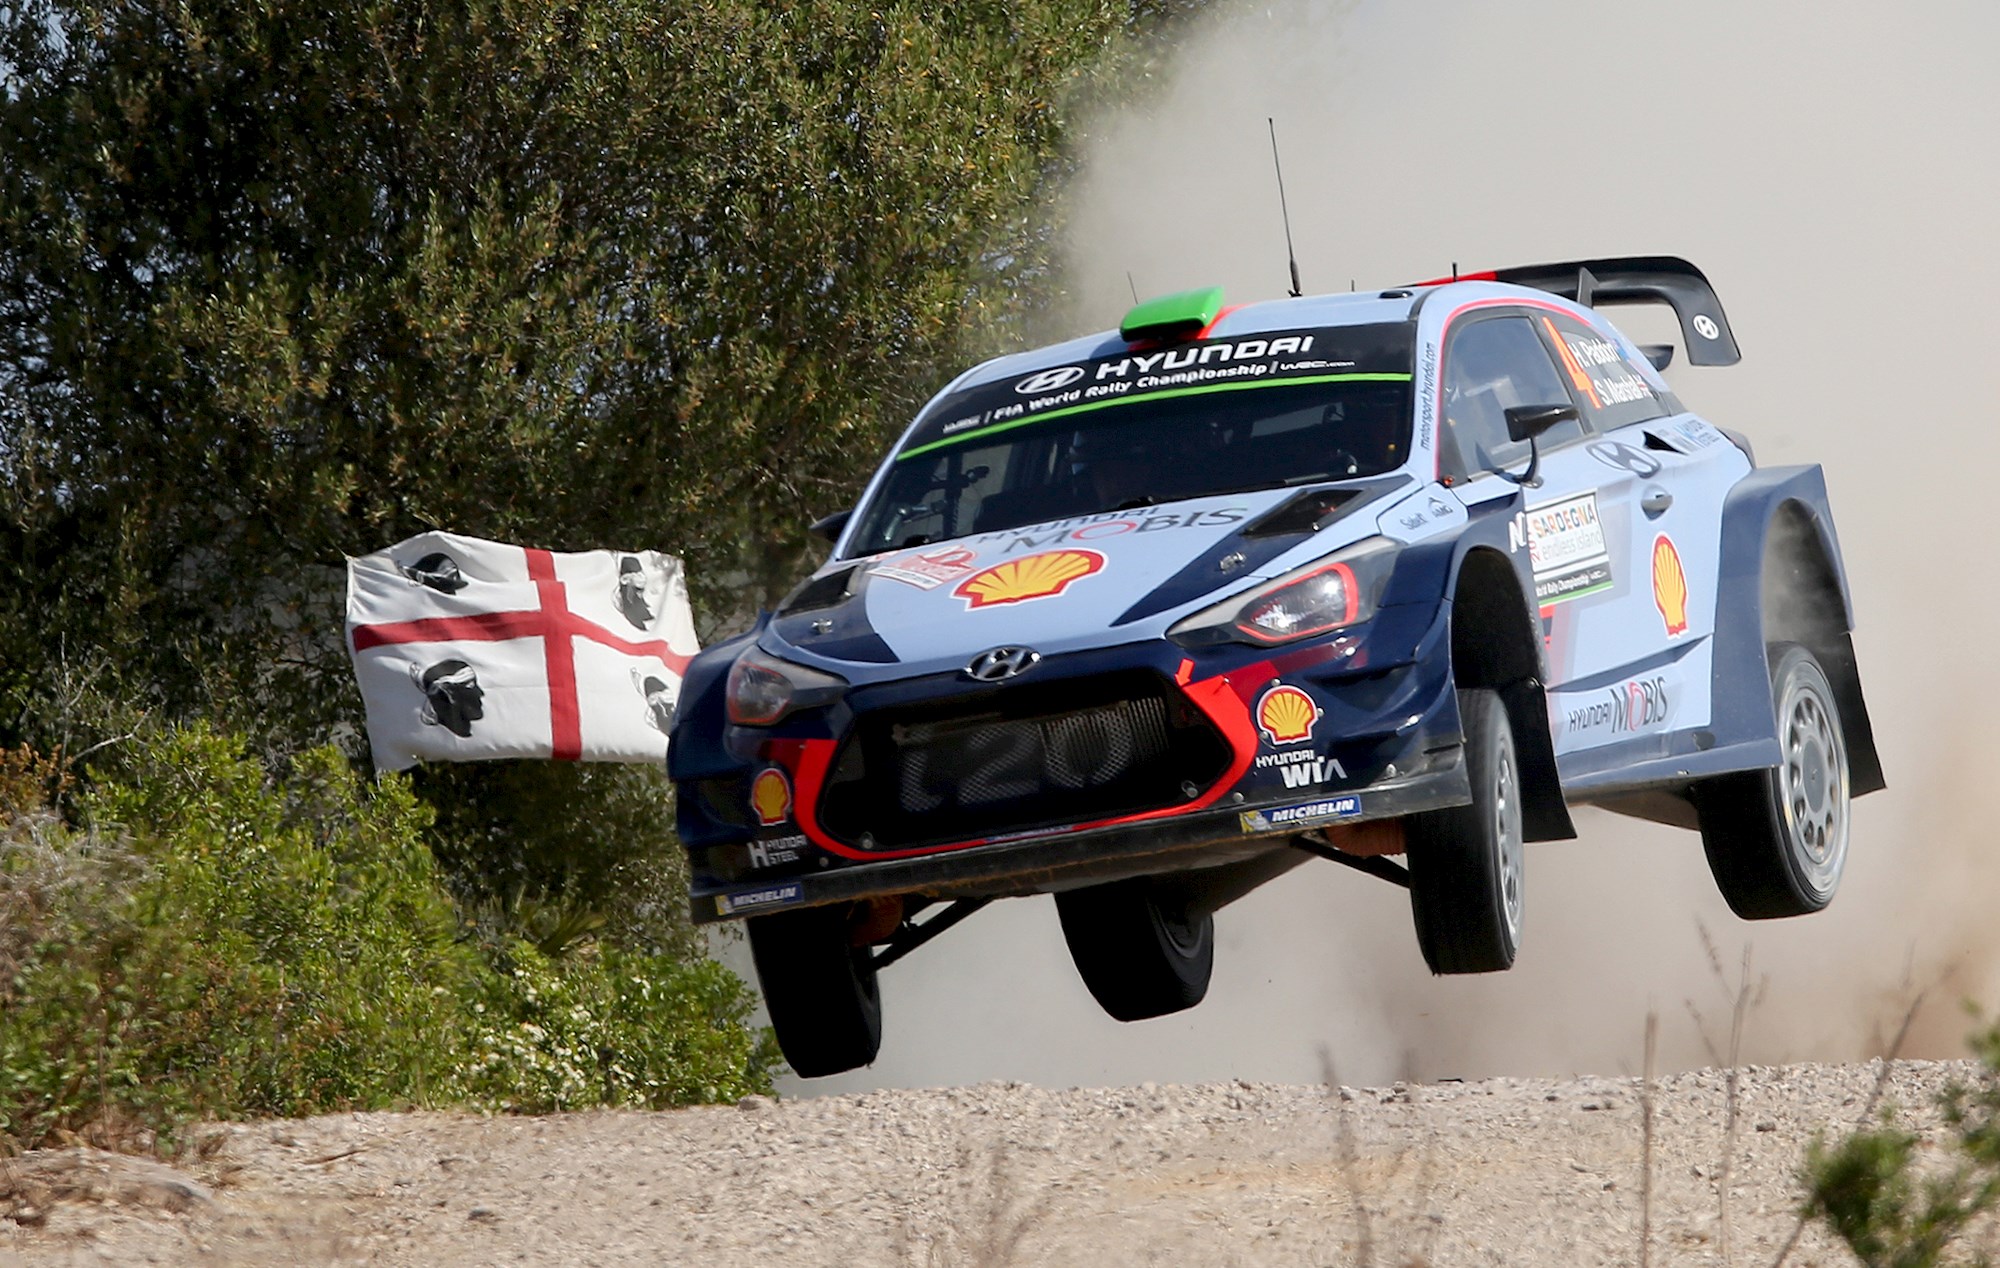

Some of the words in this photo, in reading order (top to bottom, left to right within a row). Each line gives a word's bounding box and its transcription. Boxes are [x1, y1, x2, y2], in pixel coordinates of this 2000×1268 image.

[1095, 335, 1315, 380] HYUNDAI
[993, 403, 1025, 421] FIA
[1029, 389, 1082, 411] World
[1084, 380, 1132, 398] Rally
[1136, 363, 1268, 388] Championship
[977, 507, 1160, 543] HYUNDAI
[1003, 507, 1249, 553] MOBIS
[1532, 503, 1597, 539] SARDEGNA
[1568, 701, 1611, 733] HYUNDAI
[1609, 676, 1668, 733] MOBIS
[1256, 749, 1315, 768] HYUNDAI
[1271, 798, 1355, 823] MICHELIN
[769, 850, 799, 864] STEEL
[733, 887, 796, 906] MICHELIN
